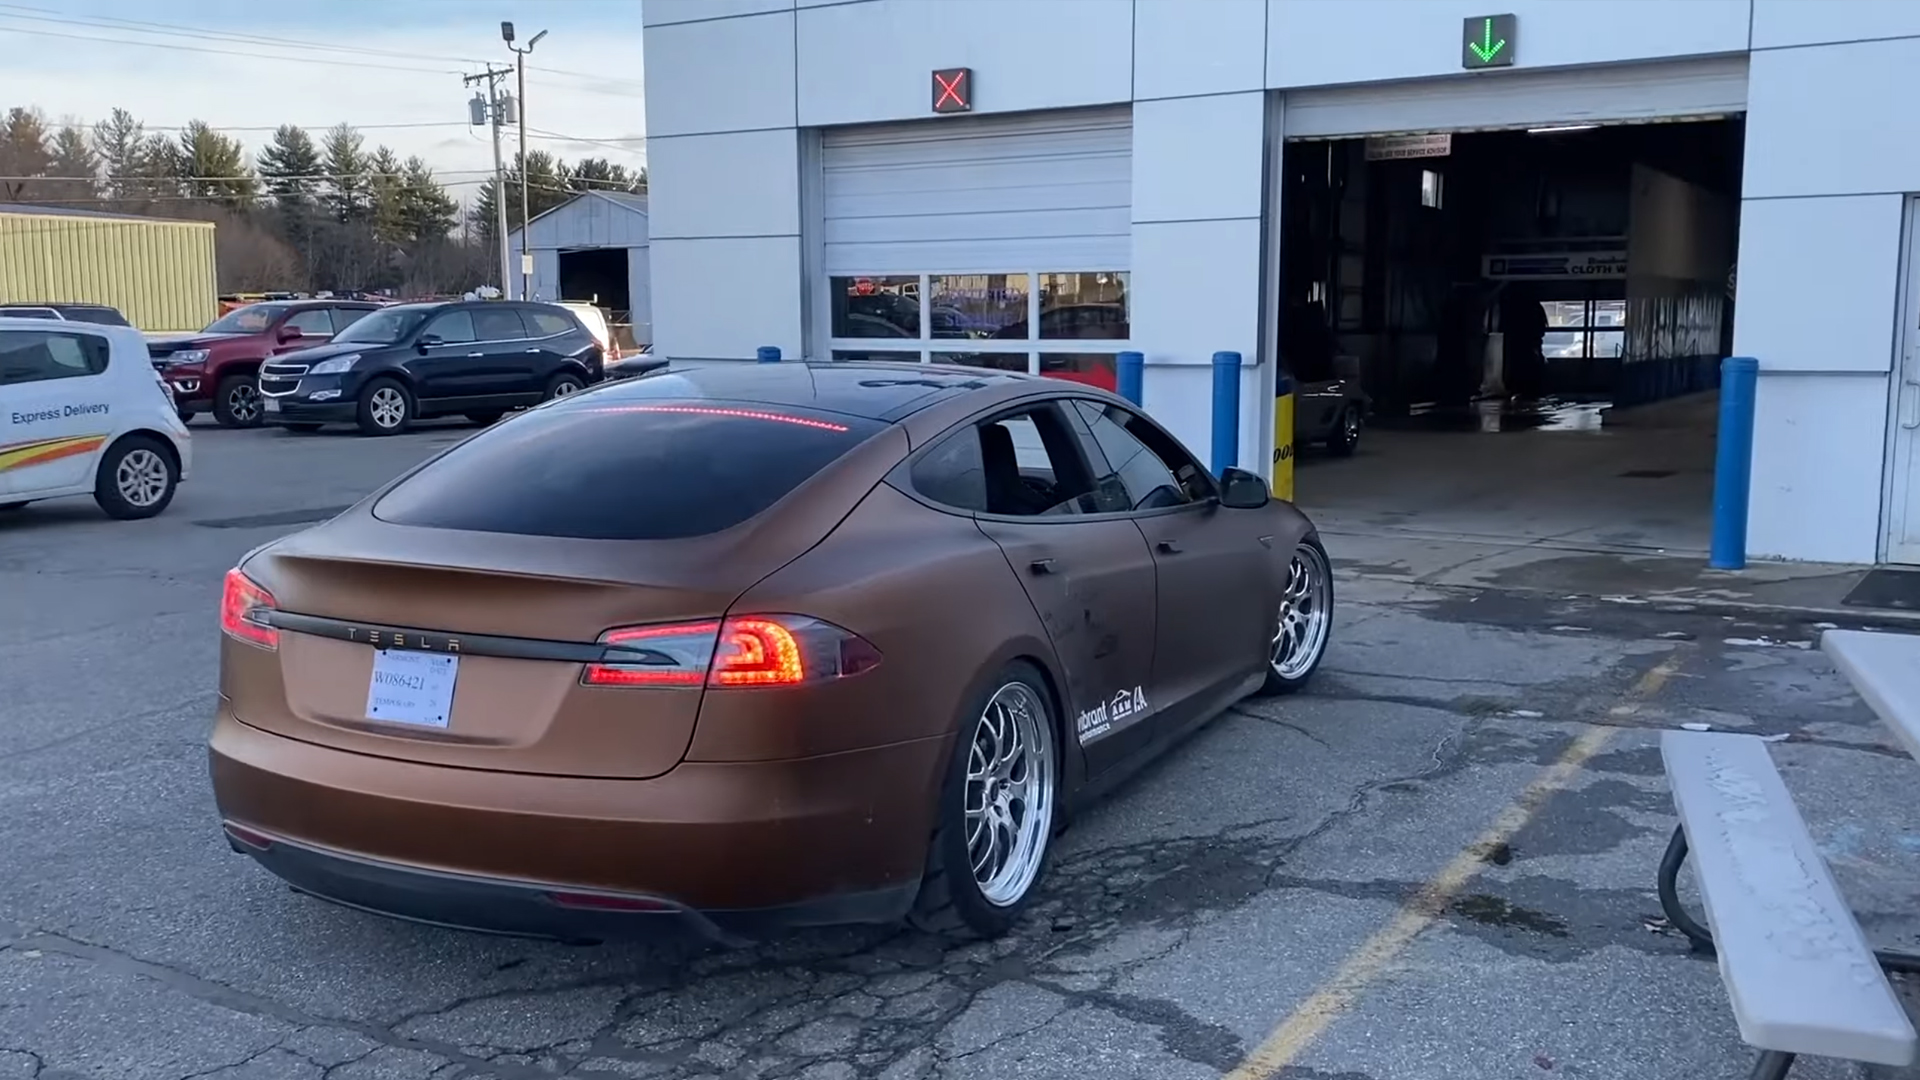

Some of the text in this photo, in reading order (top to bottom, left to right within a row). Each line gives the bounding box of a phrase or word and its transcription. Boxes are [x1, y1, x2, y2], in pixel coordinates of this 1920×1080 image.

[1571, 265, 1612, 274] CLOTH
[12, 403, 109, 425] Express Delivery
[348, 628, 460, 651] TESLA
[374, 671, 425, 690] W086421
